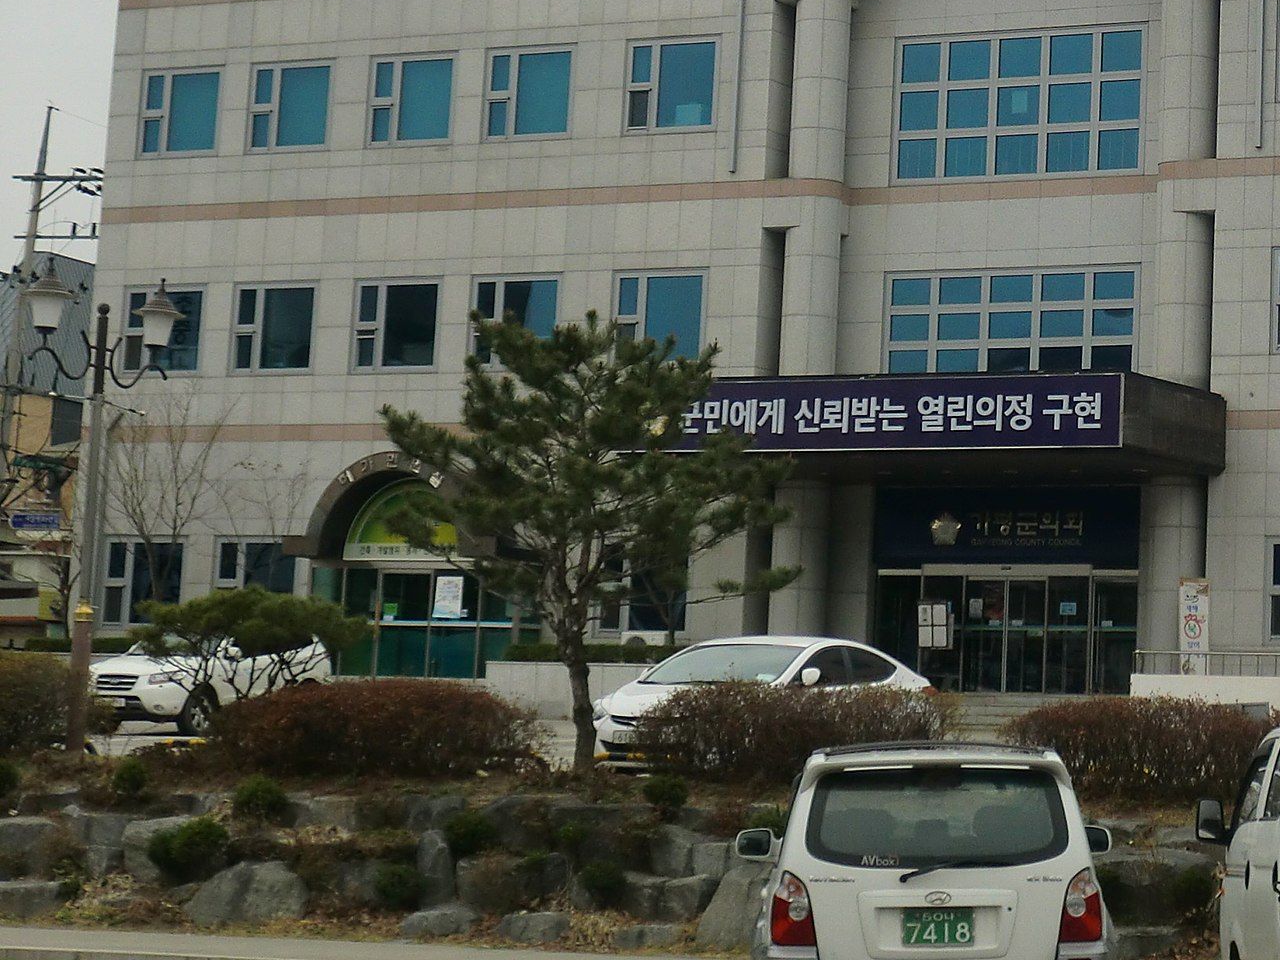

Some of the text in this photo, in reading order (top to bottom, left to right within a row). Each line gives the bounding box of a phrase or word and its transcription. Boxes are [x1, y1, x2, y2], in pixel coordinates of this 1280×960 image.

[680, 392, 1102, 434] 군민에게 신뢰받는 열린의정 구현
[906, 922, 971, 944] 7418
